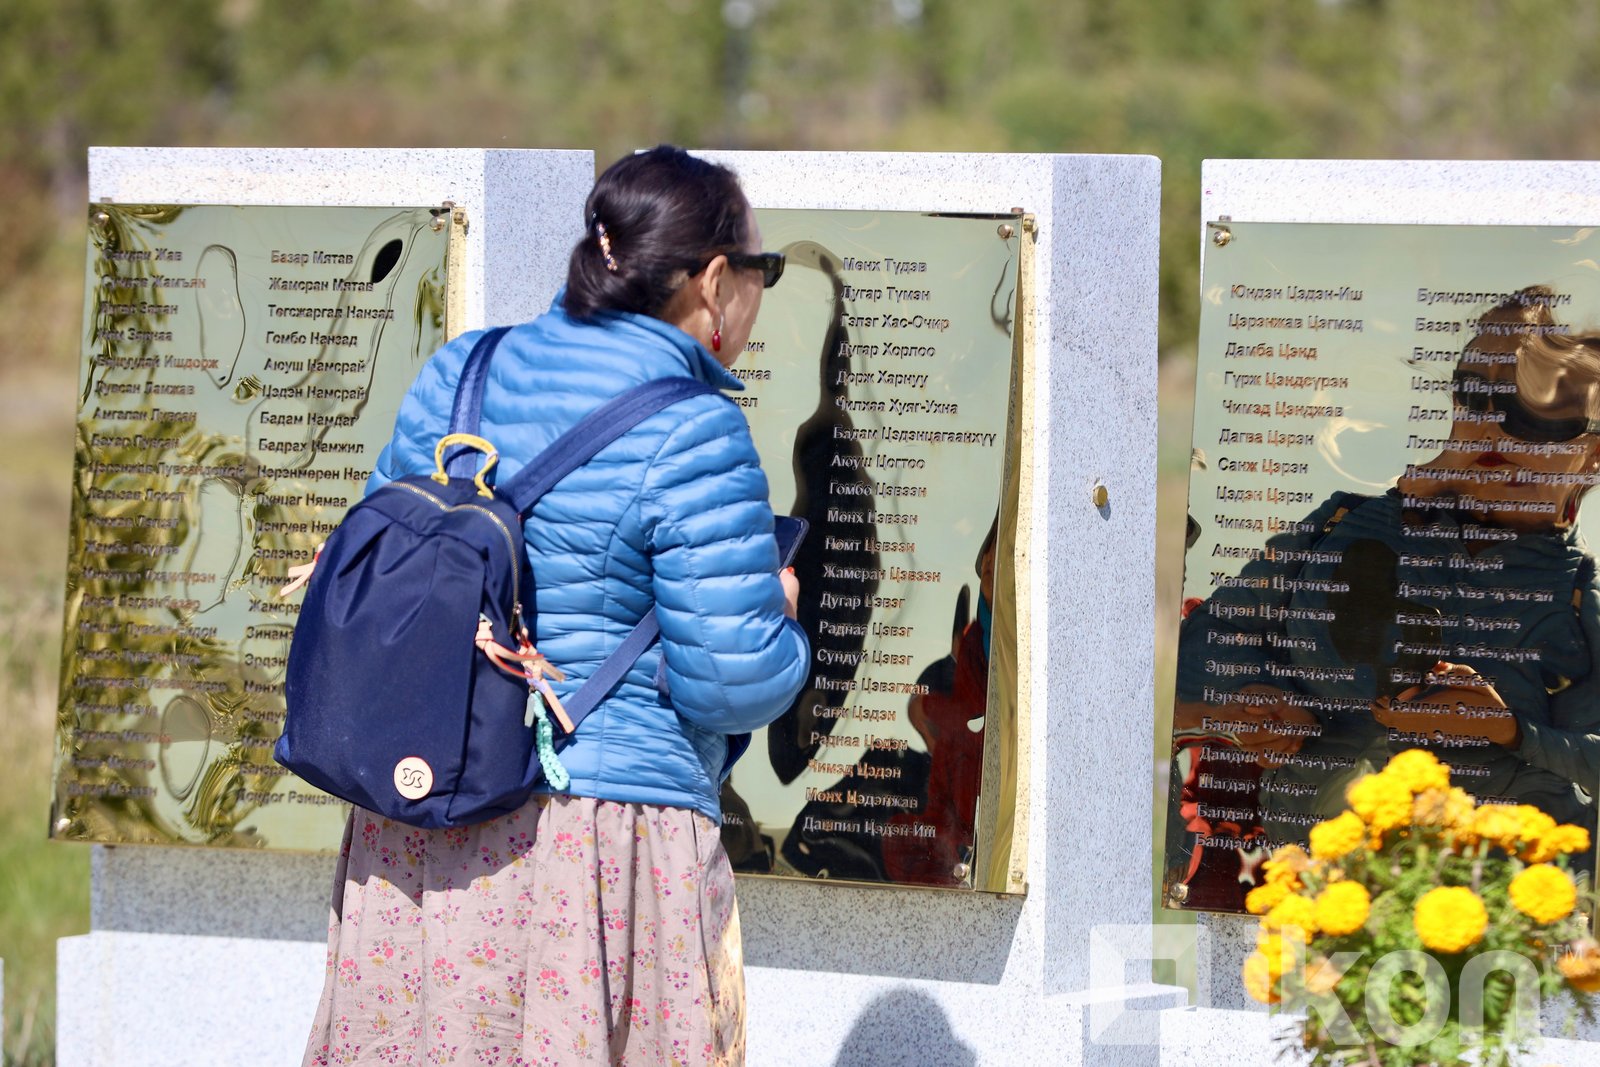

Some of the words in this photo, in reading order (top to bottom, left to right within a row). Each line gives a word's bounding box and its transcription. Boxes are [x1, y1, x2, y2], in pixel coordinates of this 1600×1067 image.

[271, 250, 309, 267] Базар
[313, 251, 354, 265] Мятав
[269, 277, 329, 293] Жамсран
[332, 279, 374, 292] Мятав
[841, 286, 882, 302] Дугар
[1231, 284, 1282, 301] Юндэн
[1287, 285, 1363, 303] Цэдэн-Иш
[1416, 287, 1512, 308] Буяндэлгэр
[346, 306, 395, 321] Нанзад
[841, 313, 879, 328] Гэлэг
[882, 314, 950, 332] Хас-Очир
[1228, 313, 1303, 331] Цэрэнжав
[1307, 315, 1363, 333] Цэгмэд
[1415, 317, 1461, 335] Базар
[266, 331, 307, 345] Гомбо
[310, 332, 358, 347] Нанзад
[838, 341, 879, 359] Дугар
[882, 342, 936, 359] Хорлоо
[1225, 342, 1274, 359] Дамба
[1278, 343, 1318, 360] Цэнд
[1412, 346, 1461, 363] Билэг
[164, 355, 220, 370] Ишдорж
[264, 358, 304, 374] Аюуш
[307, 359, 366, 375] Намсрай
[728, 367, 771, 381] аднаа
[836, 370, 874, 387] Дорж
[262, 384, 303, 400] Цэдэн
[307, 386, 366, 402] Намсрай
[889, 398, 958, 416] Хуяг-Ухна
[1223, 399, 1271, 417] Чимэд
[1275, 401, 1344, 418] Цэнджав
[260, 411, 303, 427] Бадам
[833, 425, 877, 441] Бадам
[1218, 428, 1263, 445] Дагва
[1267, 430, 1314, 448] Цэрэн
[258, 438, 307, 454] Бадрах
[311, 440, 364, 454] Намжил
[831, 453, 872, 470] Аюуш
[876, 454, 926, 471] Цогтоо
[1218, 456, 1258, 473] Санж
[1262, 458, 1309, 477] Цэрэн
[829, 480, 872, 497] Гомбо
[875, 482, 927, 499] Цэвээн
[1216, 485, 1263, 503] Цэдэн
[1267, 487, 1314, 506] Цэрэн
[306, 493, 347, 508] Нямаа
[867, 510, 918, 526] Цэвээн
[1215, 514, 1264, 533] Чимэд
[864, 537, 916, 554] Цэвээн
[1212, 543, 1260, 562] Ананд
[822, 563, 886, 582] Жамсран
[889, 566, 941, 583] Цэвээн
[1210, 571, 1269, 589] Жалсан
[249, 600, 300, 615] Жамсра
[820, 592, 861, 610] Дугар
[864, 593, 906, 609] Цэвэг
[1208, 600, 1255, 619] Цэрэн
[819, 620, 868, 637] Раднаа
[872, 622, 914, 639] Цэвэг
[245, 653, 288, 668] Эрдэн
[817, 648, 868, 666] Сундуй
[872, 650, 914, 666] Цэвэг
[1205, 659, 1261, 677] Эрдэнэ
[815, 675, 857, 691] Мятав
[861, 678, 930, 695] Цэвэгжав
[812, 704, 849, 719] Санж
[852, 705, 897, 722] Цэдэн
[810, 731, 861, 748] Раднаа
[864, 734, 908, 751] Цэдэн
[857, 762, 902, 779] Цэдэн
[803, 816, 860, 833] Дашпил
